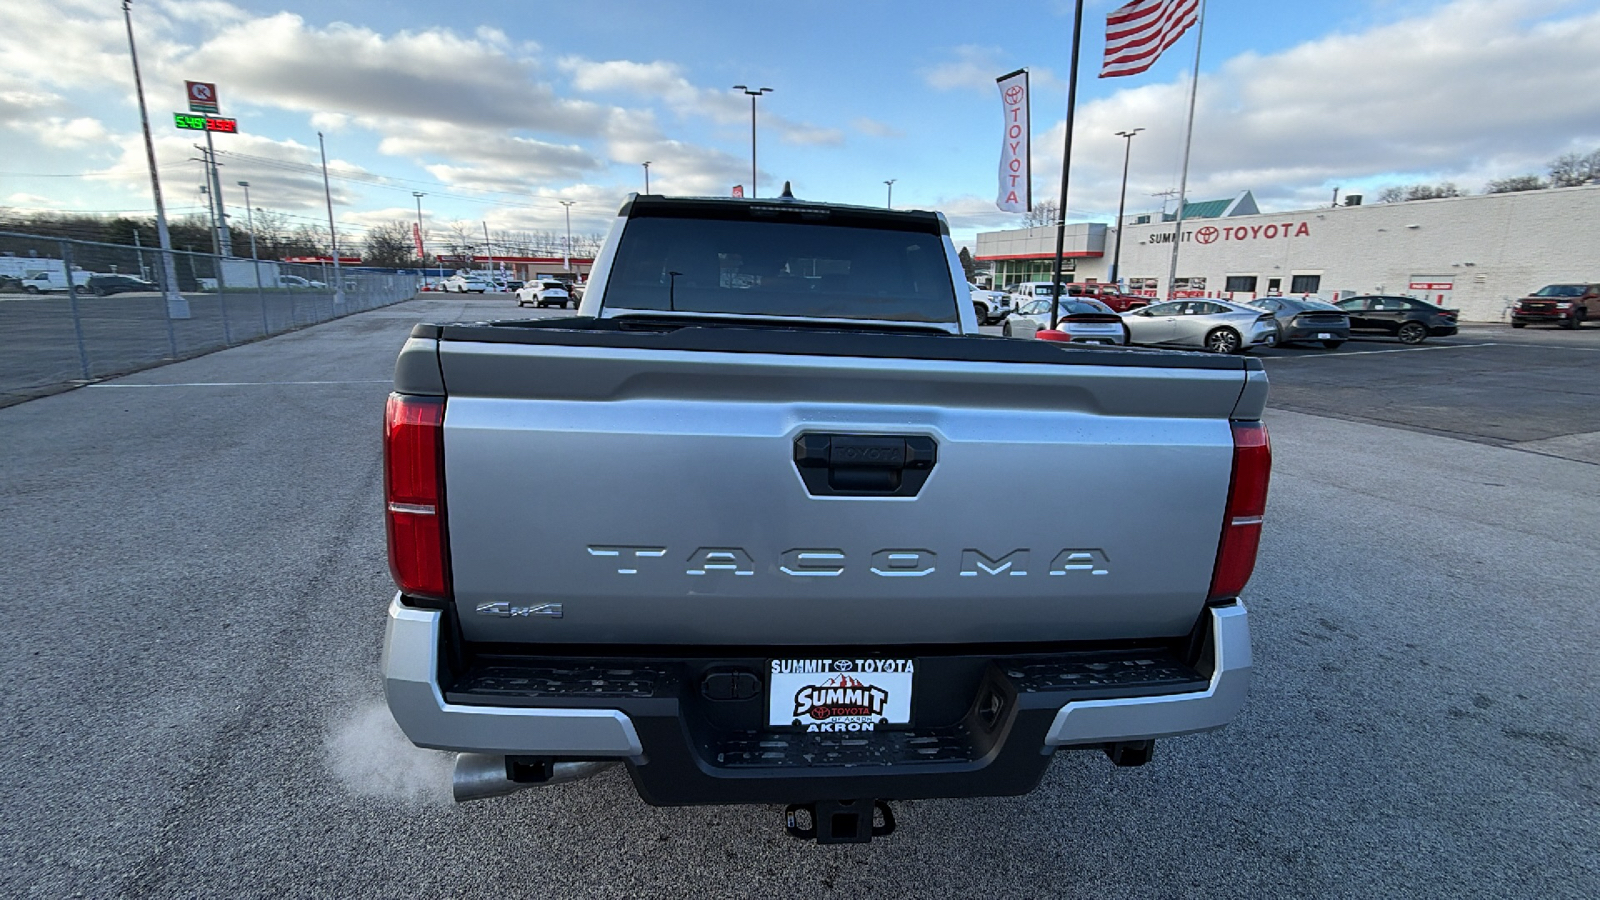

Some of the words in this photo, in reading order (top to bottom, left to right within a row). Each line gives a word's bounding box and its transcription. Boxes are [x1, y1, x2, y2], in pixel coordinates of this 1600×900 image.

[1005, 108, 1021, 203] TOYOTA
[1222, 222, 1310, 241] TOYOTA
[587, 545, 1109, 576] TACOMA
[771, 659, 832, 673] SUMMIT
[855, 659, 914, 673] TOYOTA
[797, 687, 885, 714] SUMMIT
[831, 707, 870, 716] TOYOTA
[807, 722, 875, 732] AKRON
